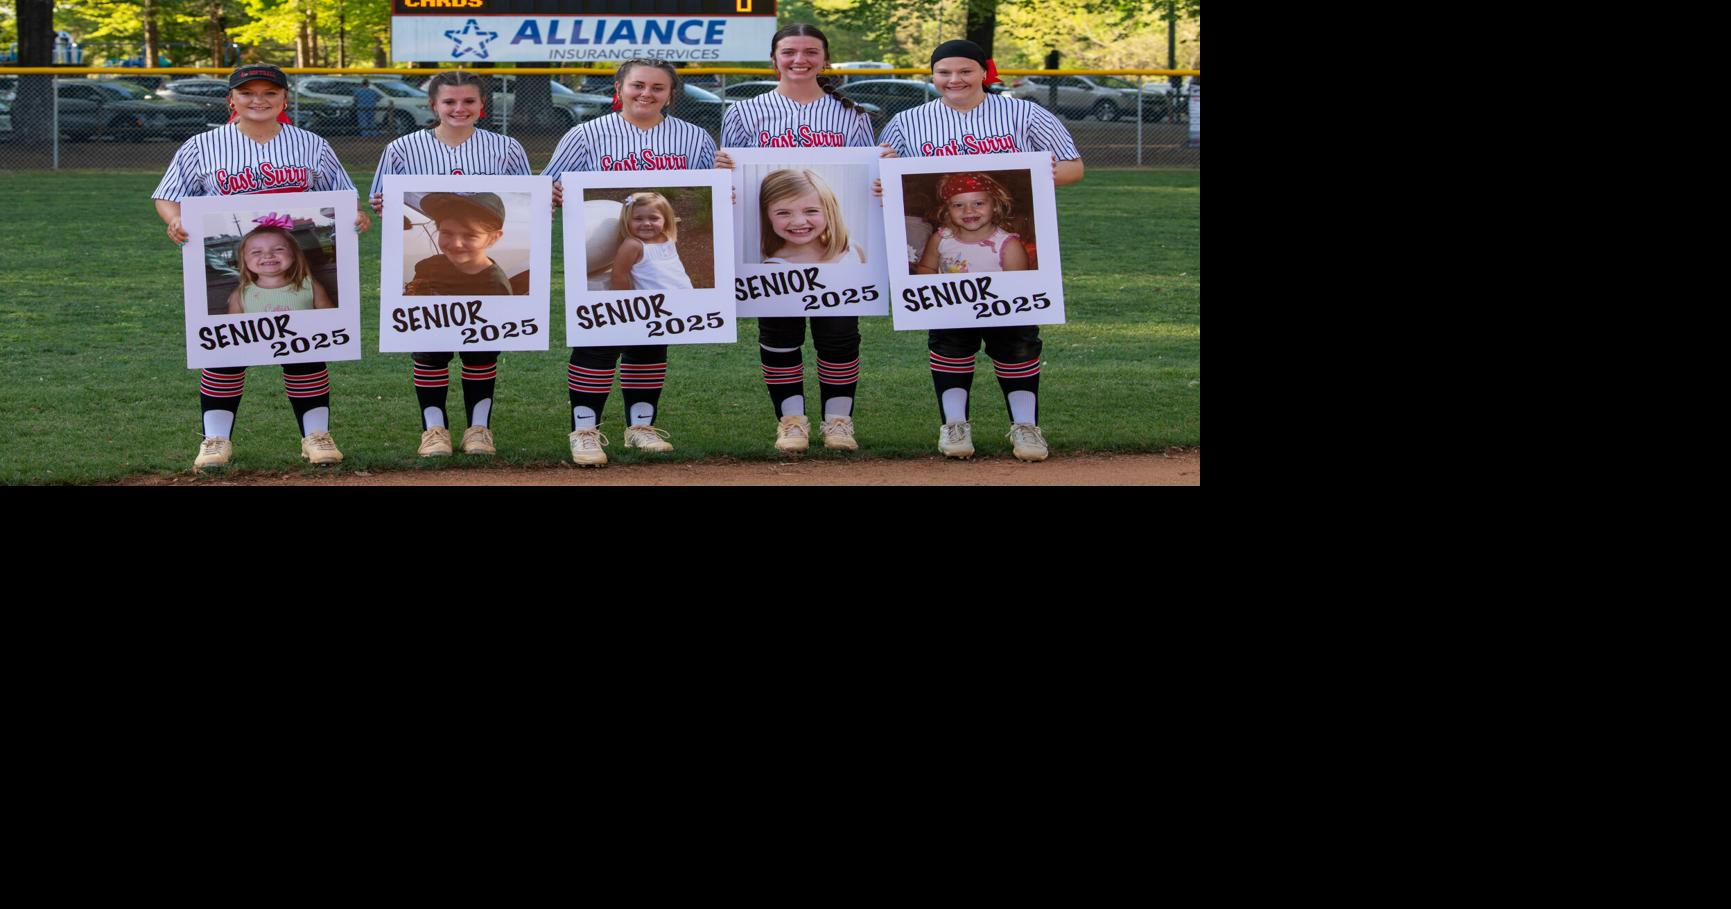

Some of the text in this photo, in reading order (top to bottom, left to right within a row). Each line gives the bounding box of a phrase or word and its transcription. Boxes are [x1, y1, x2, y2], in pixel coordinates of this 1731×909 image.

[510, 19, 727, 46] ALLIANCE
[549, 48, 720, 60] INSURANCE SERVICES
[799, 124, 845, 148] Surry
[963, 134, 1019, 155] Surry
[641, 148, 688, 171] Surry
[216, 162, 309, 196] East Surry
[735, 267, 826, 301] SENIOR
[902, 276, 998, 312] SENIOR
[576, 293, 672, 329] SENIOR
[802, 285, 879, 311] 2025
[973, 292, 1051, 319] 2025
[392, 300, 488, 333] SENIOR
[646, 312, 724, 337] 2025
[199, 314, 297, 350] SENIOR
[270, 328, 350, 358] 2025
[461, 318, 539, 344] 2025
